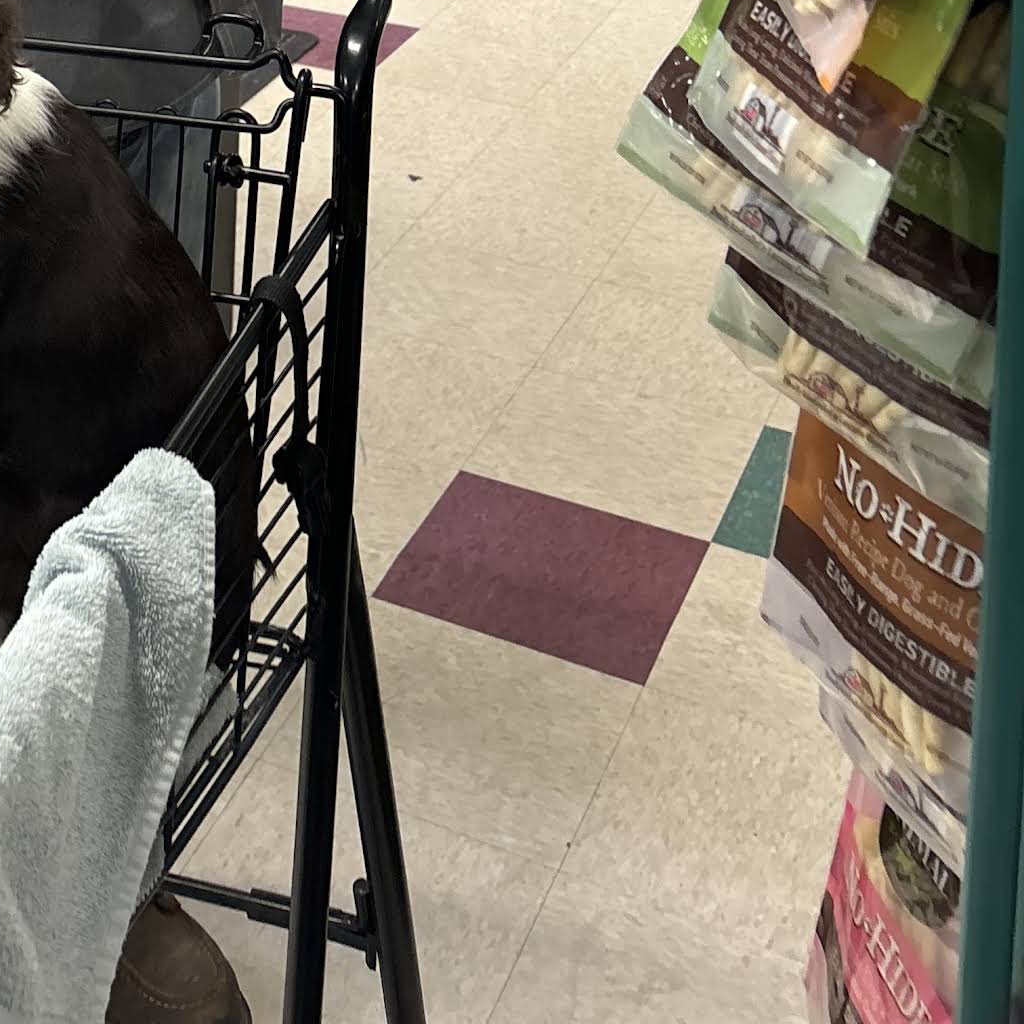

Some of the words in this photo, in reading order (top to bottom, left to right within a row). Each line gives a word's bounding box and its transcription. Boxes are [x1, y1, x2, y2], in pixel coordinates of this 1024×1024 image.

[749, 0, 793, 42] EASILY
[826, 556, 867, 615] EASILY
[867, 606, 975, 701] DIGESTIBLE
